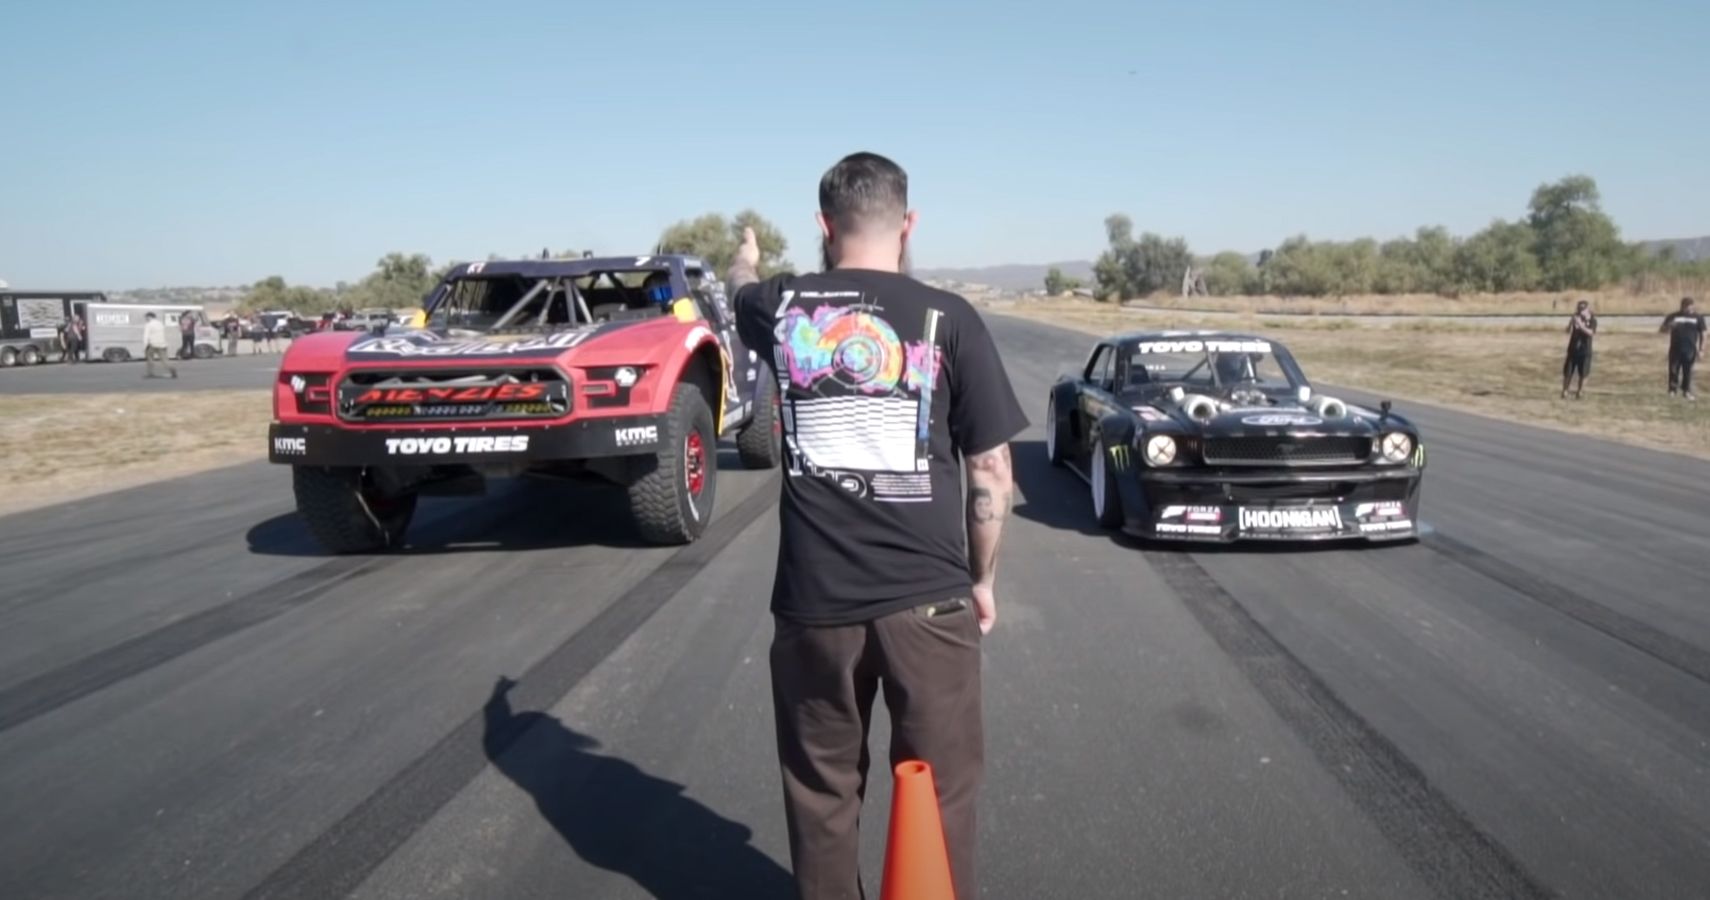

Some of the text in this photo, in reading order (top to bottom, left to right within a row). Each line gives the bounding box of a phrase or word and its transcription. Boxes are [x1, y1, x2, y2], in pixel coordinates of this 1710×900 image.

[1138, 341, 1272, 354] TOYO TIRES
[615, 425, 658, 441] KMC
[385, 435, 529, 454] TOYO TIRES
[1186, 505, 1221, 513] FORZA
